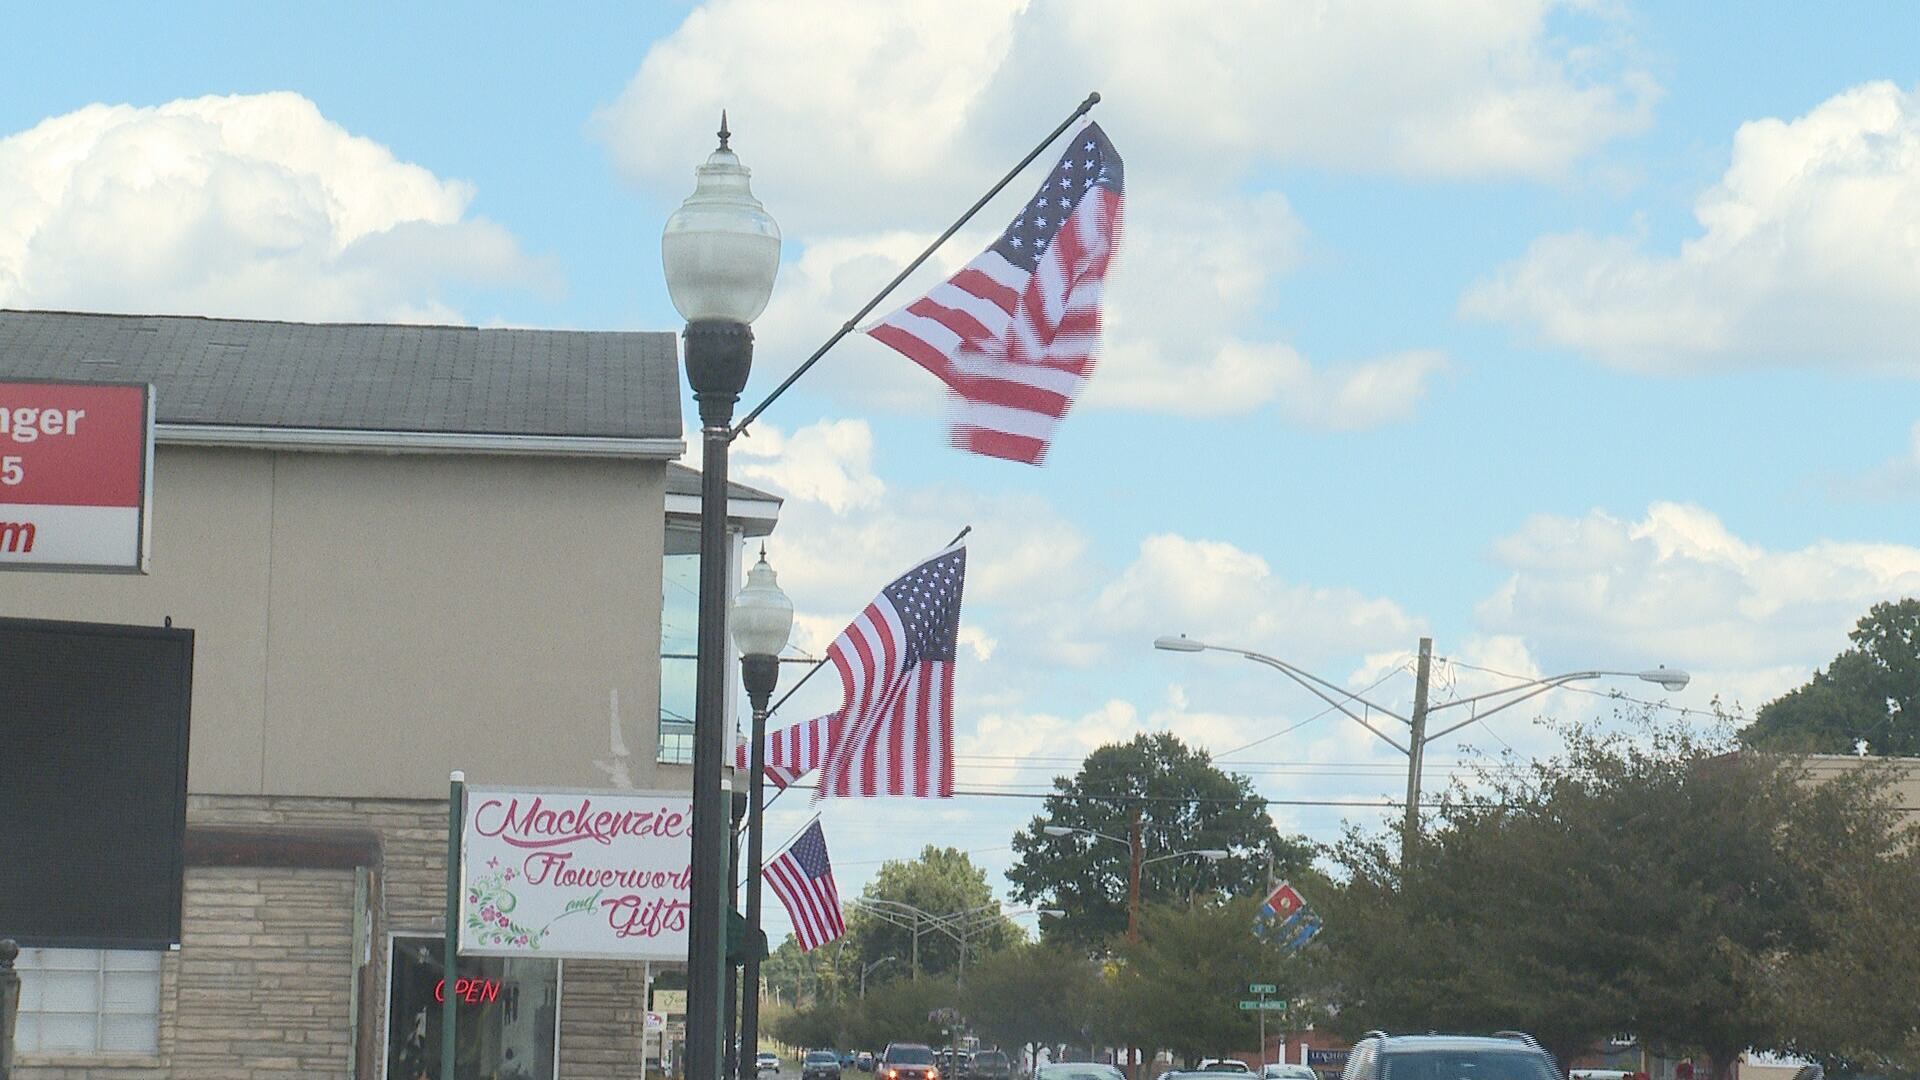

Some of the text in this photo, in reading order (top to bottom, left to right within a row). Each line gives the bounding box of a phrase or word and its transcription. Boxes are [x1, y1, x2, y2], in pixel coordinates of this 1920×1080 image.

[1, 455, 25, 486] 5
[564, 889, 691, 938] and Gifts
[434, 978, 501, 1003] OPEN
